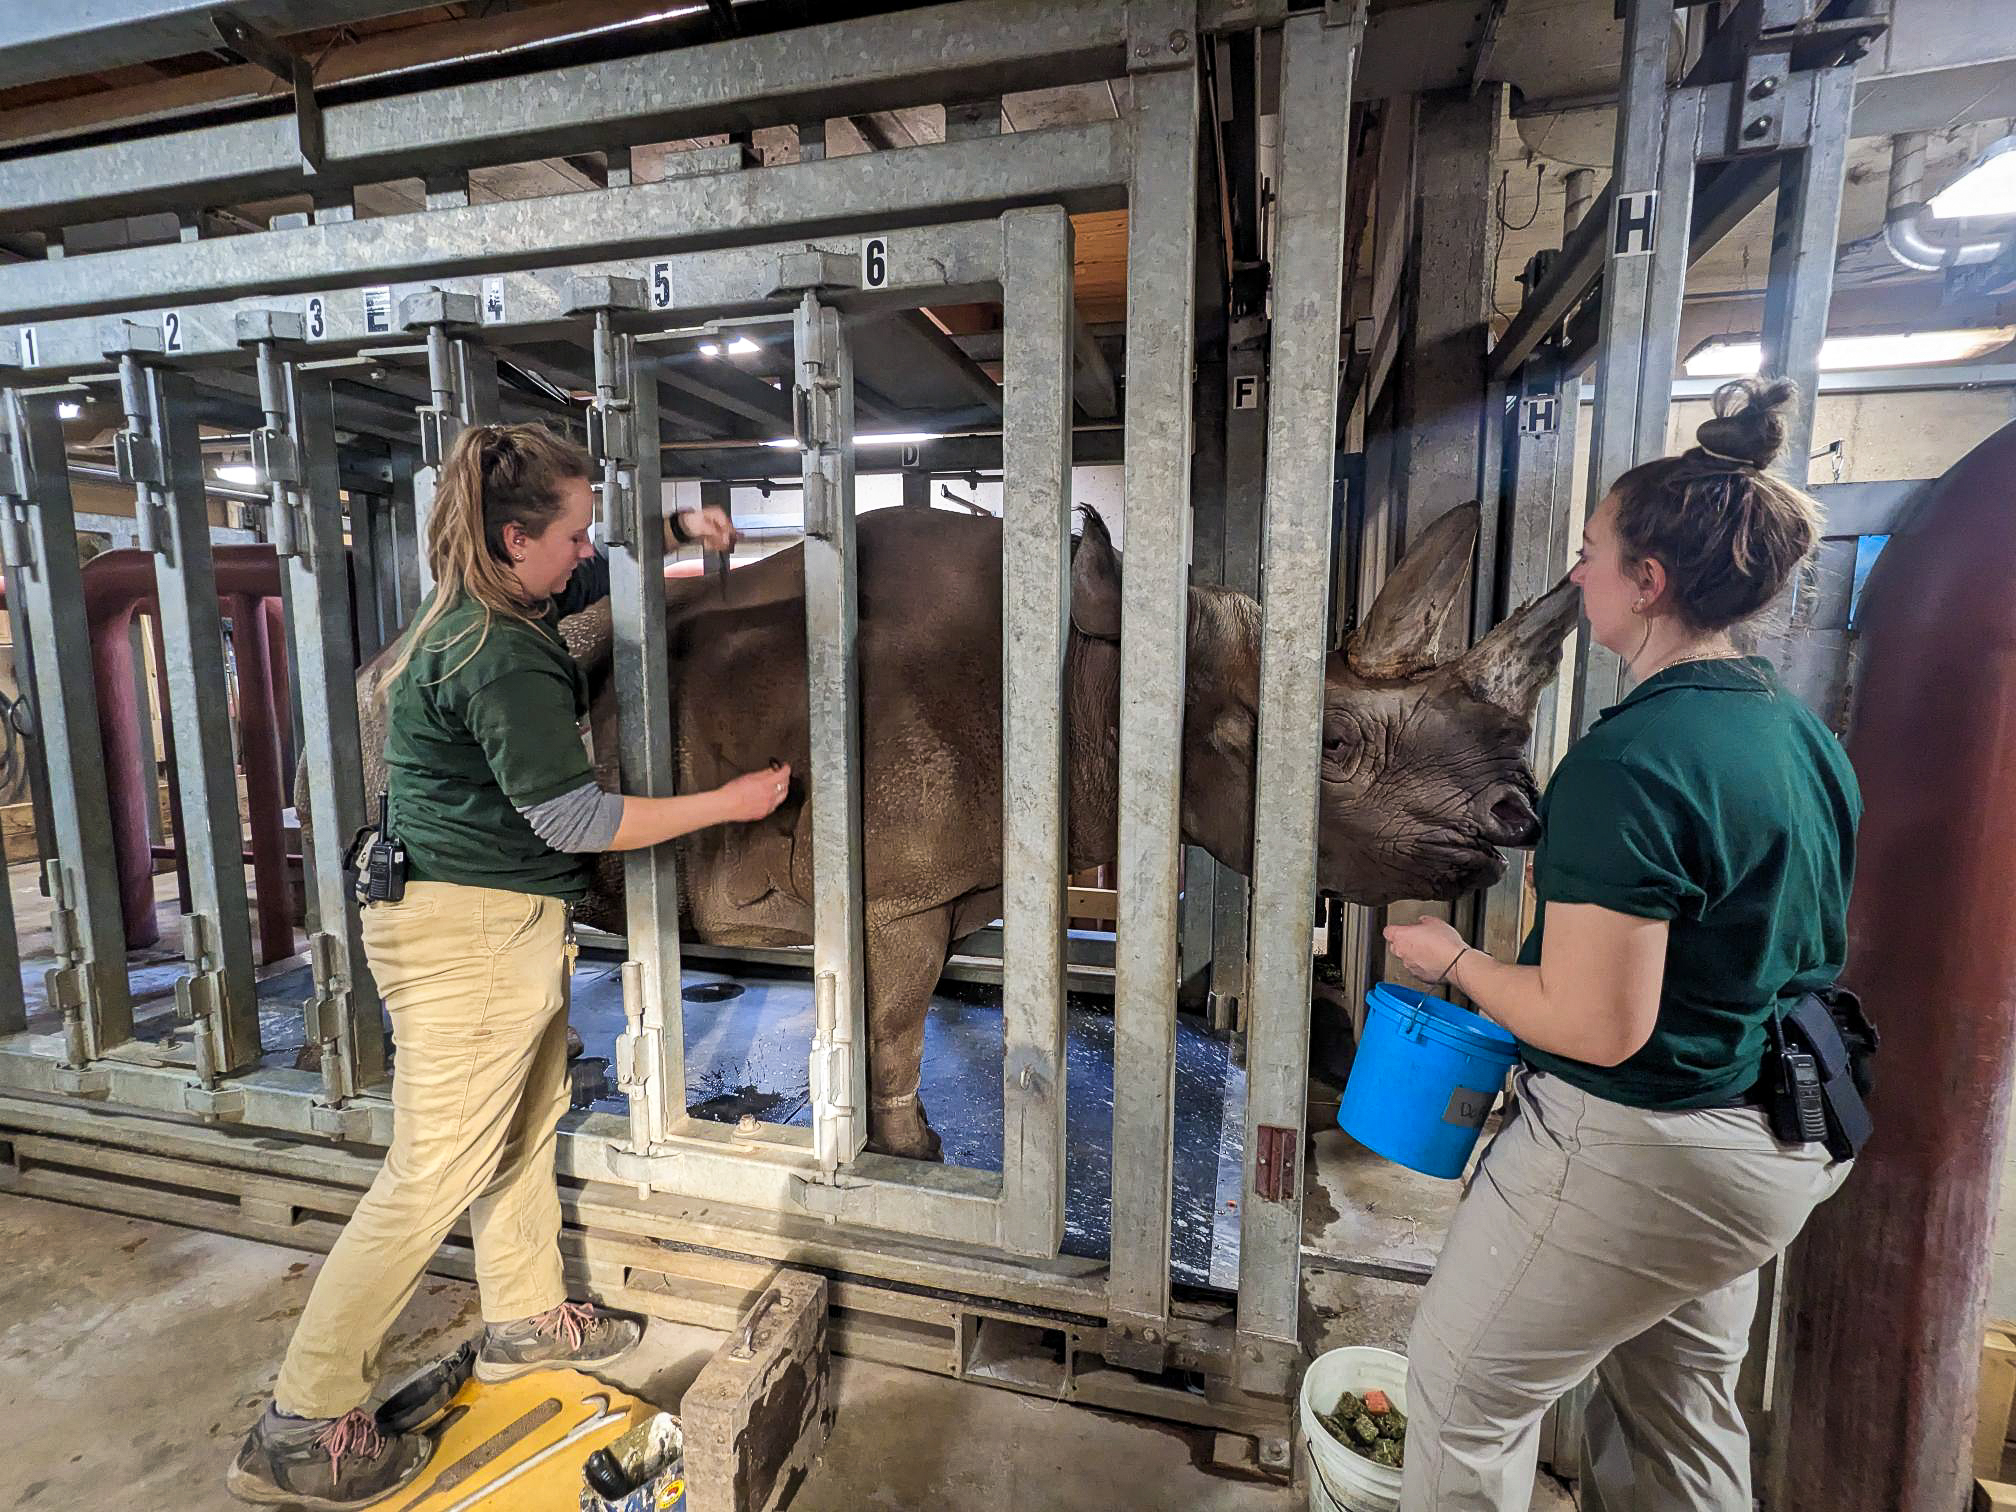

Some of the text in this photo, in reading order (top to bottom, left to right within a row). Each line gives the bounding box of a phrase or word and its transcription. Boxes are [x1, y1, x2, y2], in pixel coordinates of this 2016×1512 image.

[1615, 195, 1658, 254] H
[866, 239, 885, 286] 6
[654, 263, 670, 307] 5
[310, 298, 324, 337] 3
[366, 292, 389, 332] E
[26, 329, 35, 365] 1
[166, 313, 181, 350] 2
[1236, 378, 1255, 407] F
[1529, 401, 1552, 431] H
[904, 447, 917, 465] D
